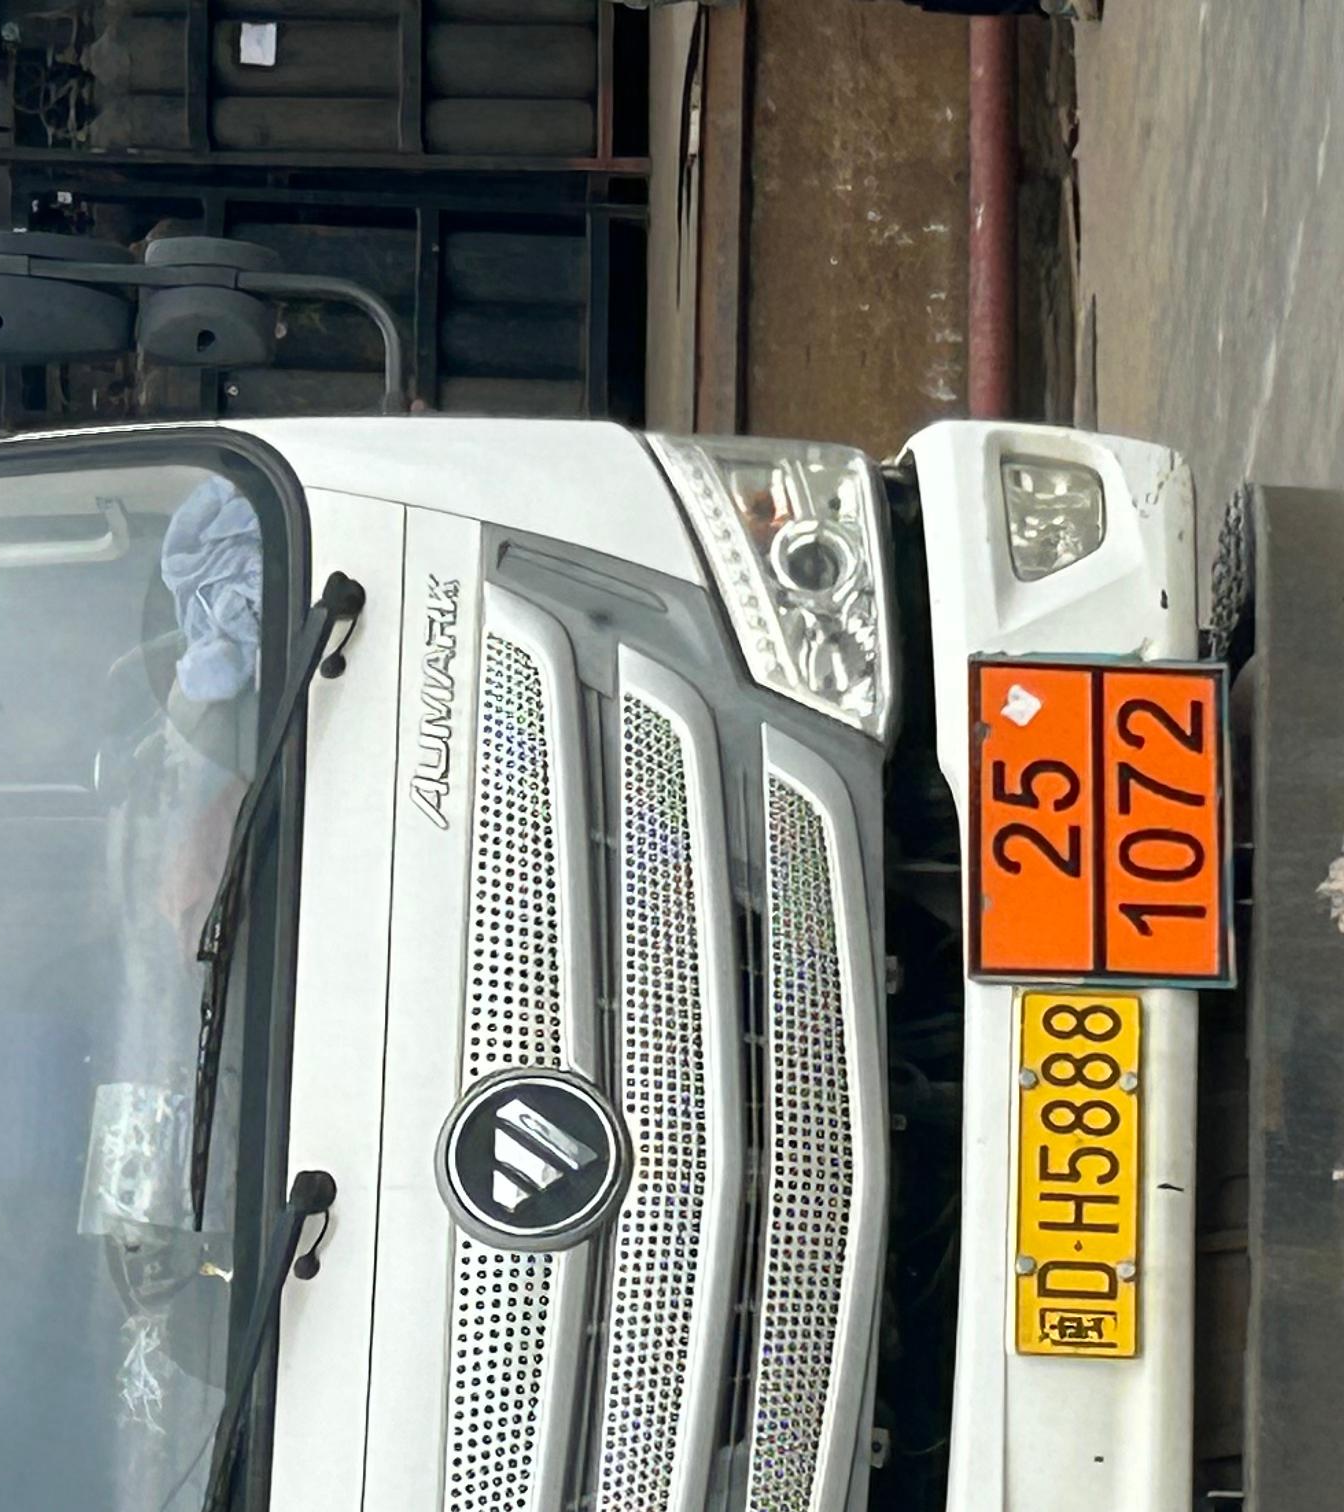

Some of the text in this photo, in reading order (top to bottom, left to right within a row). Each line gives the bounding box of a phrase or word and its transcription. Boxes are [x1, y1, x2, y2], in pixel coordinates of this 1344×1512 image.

[409, 573, 460, 830] AUMARK
[992, 758, 1082, 878] 25
[1117, 699, 1207, 937] 1072
